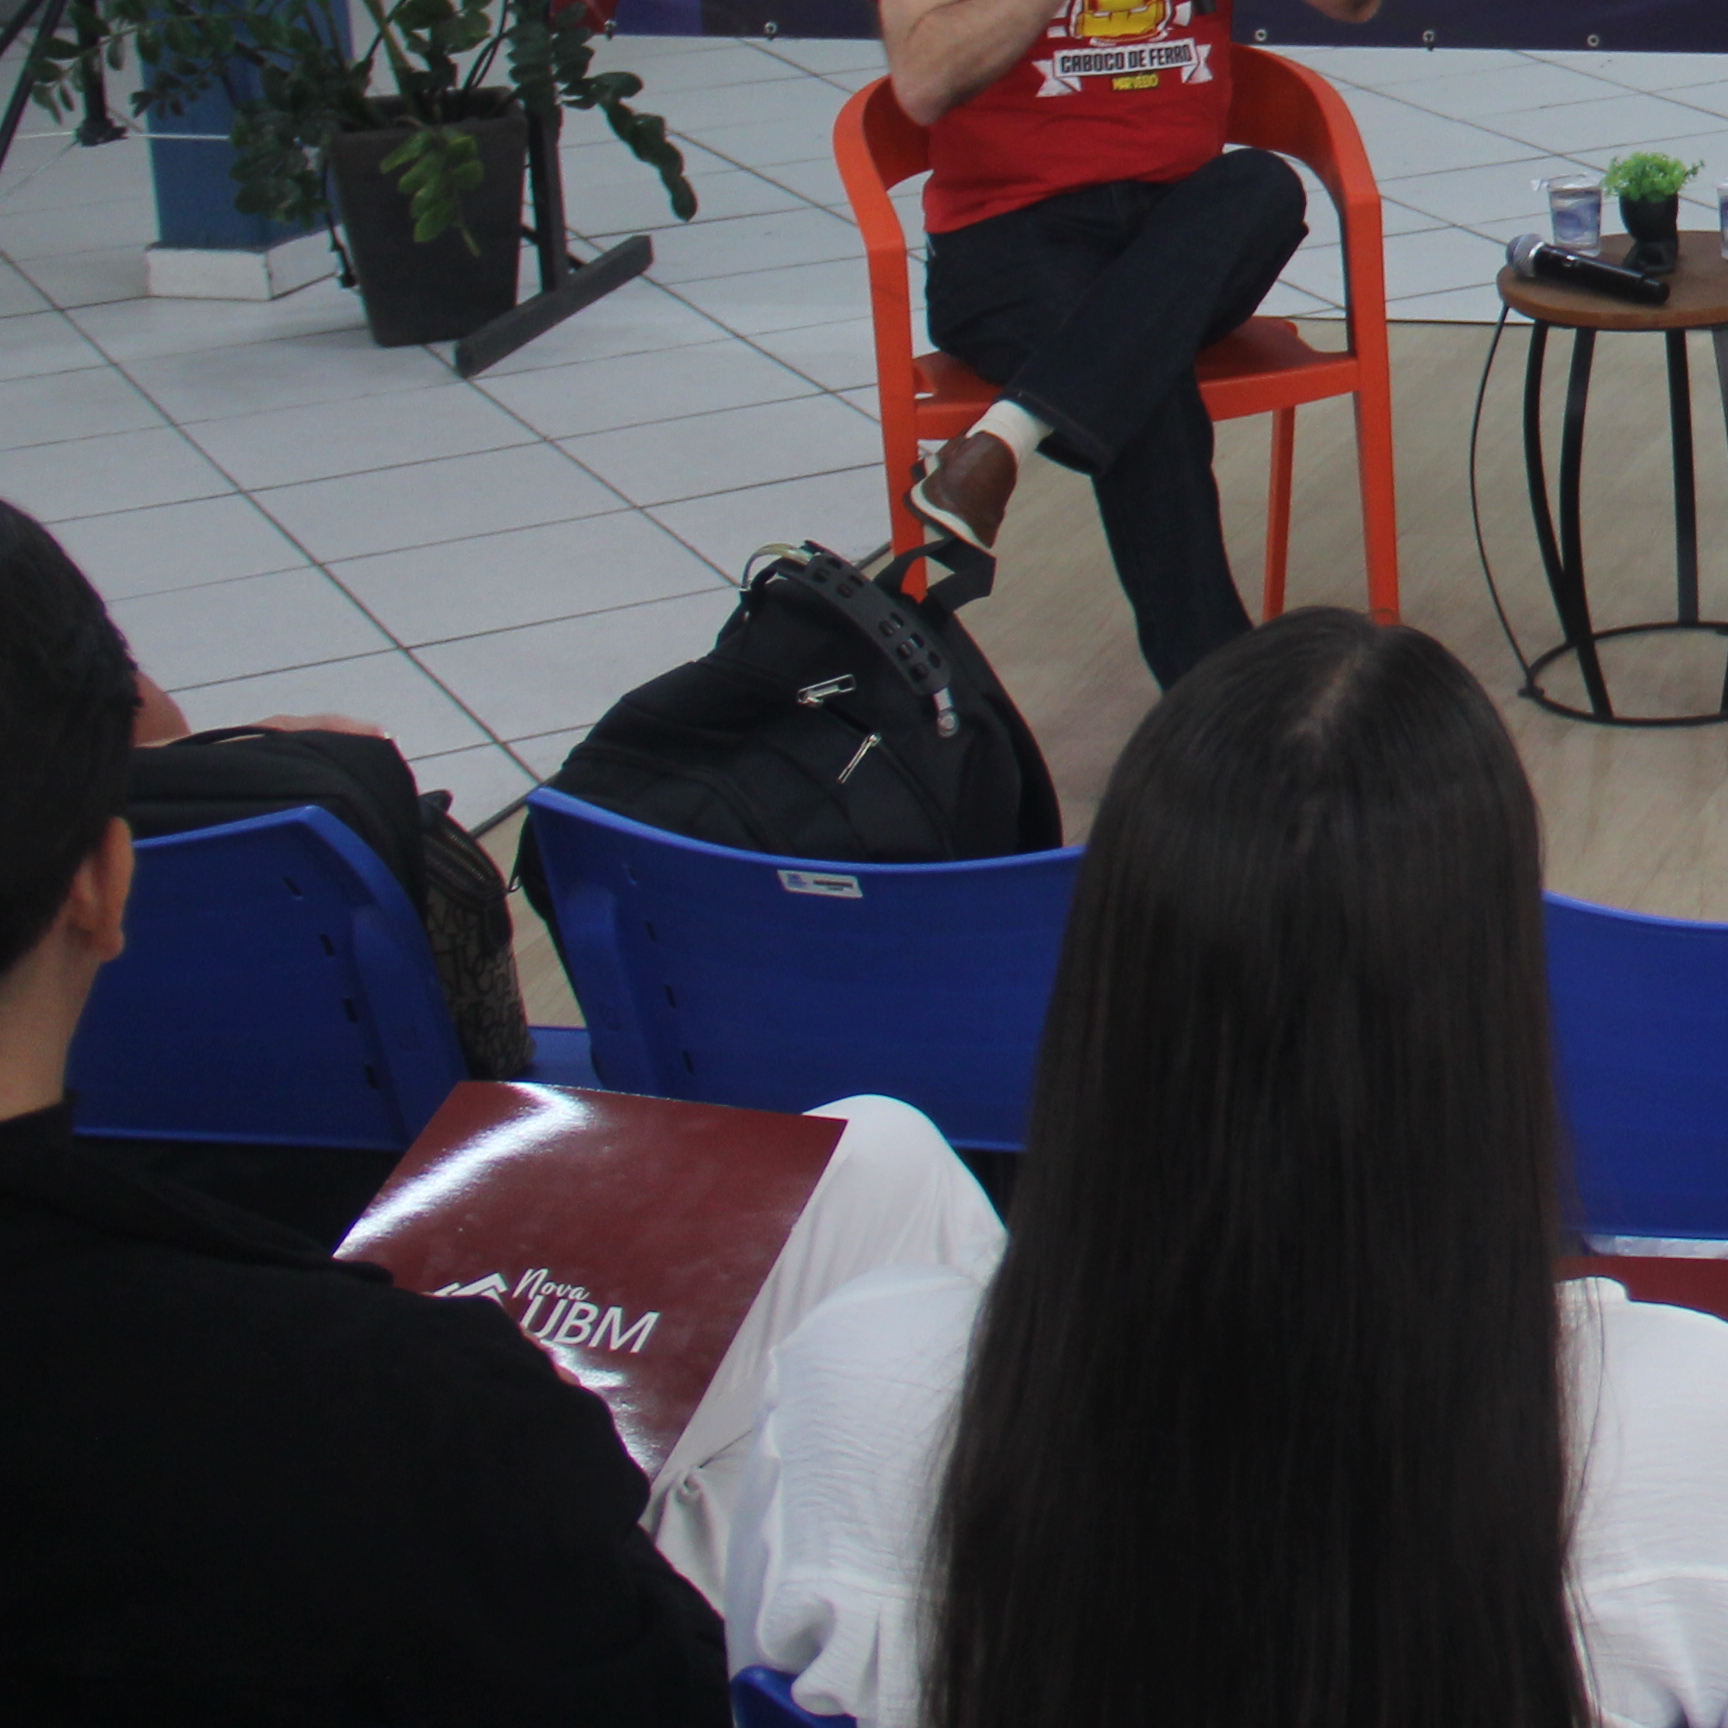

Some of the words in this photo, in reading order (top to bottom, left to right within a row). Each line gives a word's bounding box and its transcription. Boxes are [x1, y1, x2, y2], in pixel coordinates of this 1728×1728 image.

[1061, 52, 1125, 73] CABOCO
[1128, 49, 1145, 70] DE
[1149, 44, 1192, 67] FERRO
[512, 1268, 590, 1302] Nova
[520, 1294, 660, 1354] UBM
